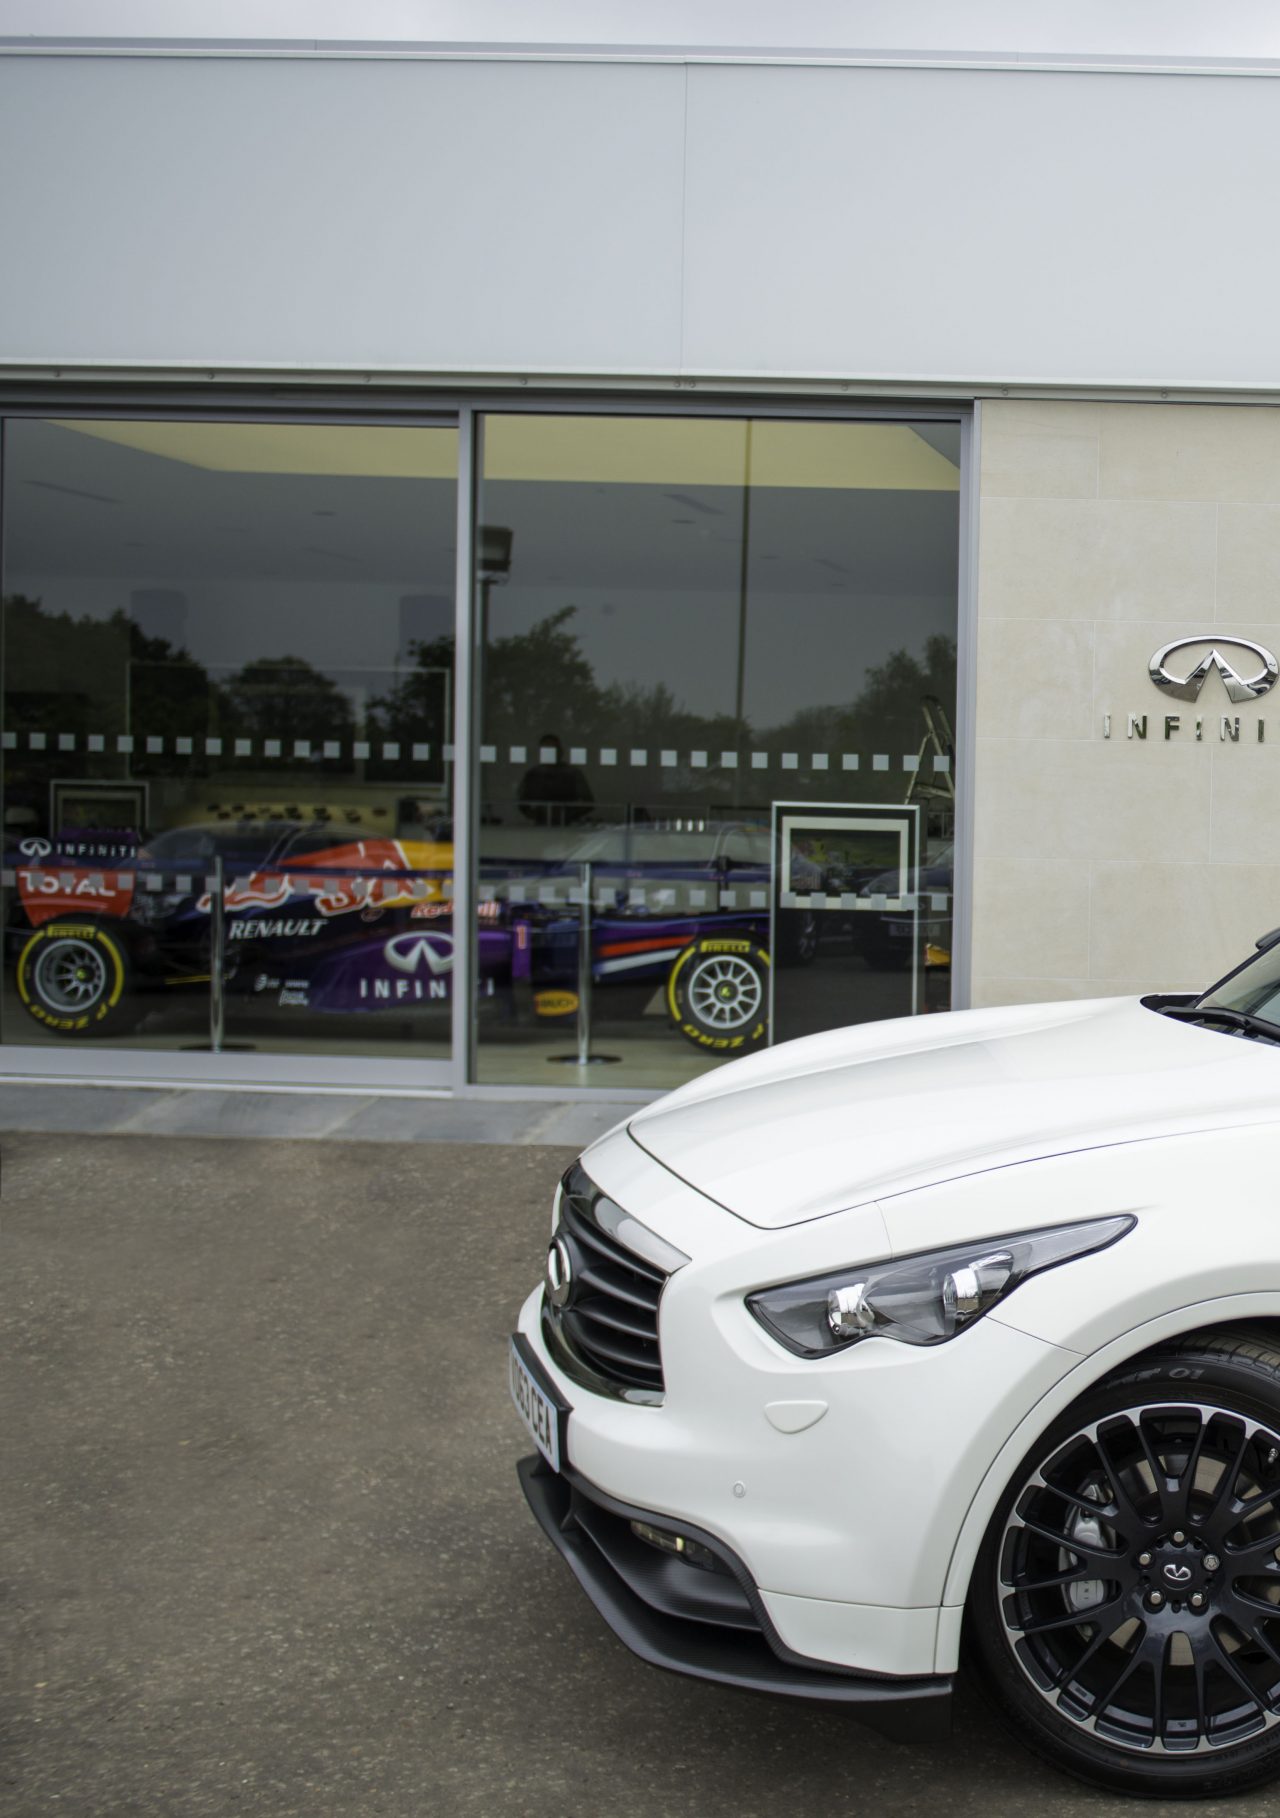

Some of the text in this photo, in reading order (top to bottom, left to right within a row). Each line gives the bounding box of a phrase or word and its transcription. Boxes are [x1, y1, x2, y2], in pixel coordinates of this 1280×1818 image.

[56, 843, 136, 858] INFINITI
[228, 918, 330, 940] RENAULT
[360, 976, 496, 999] INFINI
